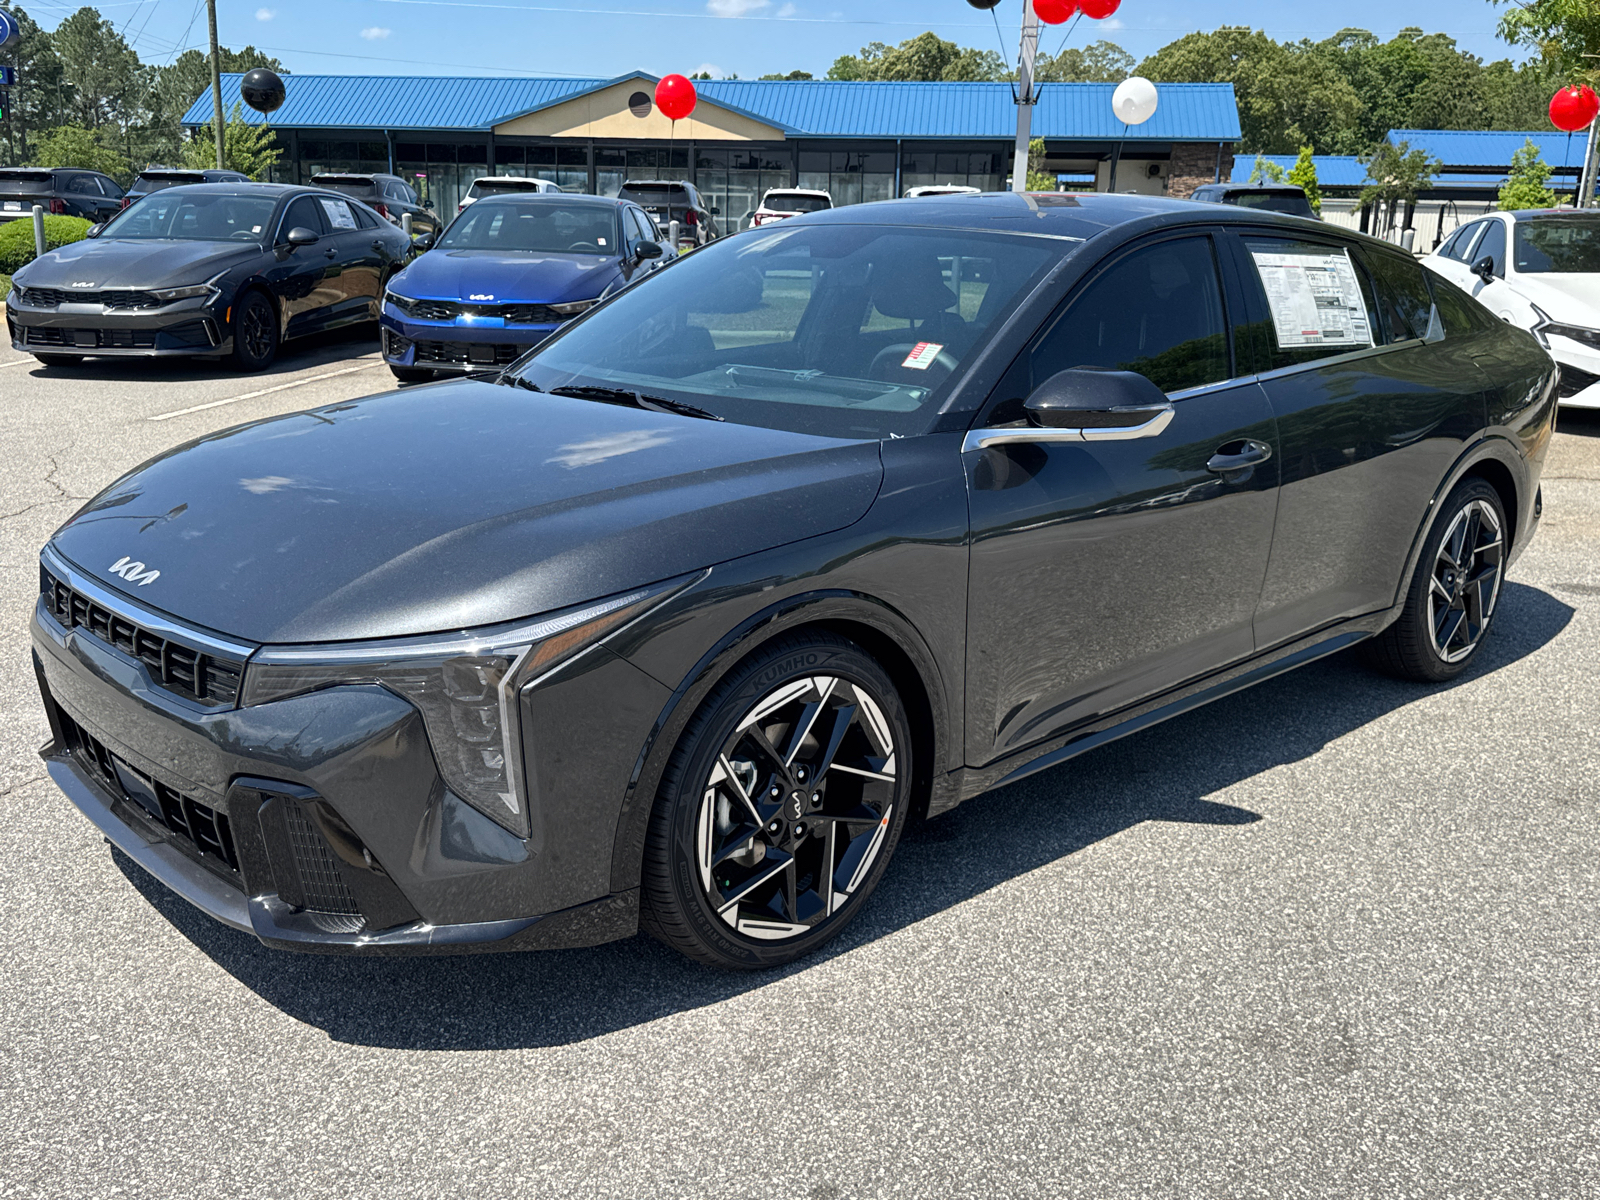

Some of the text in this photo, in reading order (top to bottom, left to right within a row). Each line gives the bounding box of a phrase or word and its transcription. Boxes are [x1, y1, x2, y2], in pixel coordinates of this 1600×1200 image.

[108, 556, 161, 586] KIA
[753, 654, 817, 691] KUMHO
[792, 792, 802, 819] KIA
[681, 862, 692, 897] OUTSIDE
